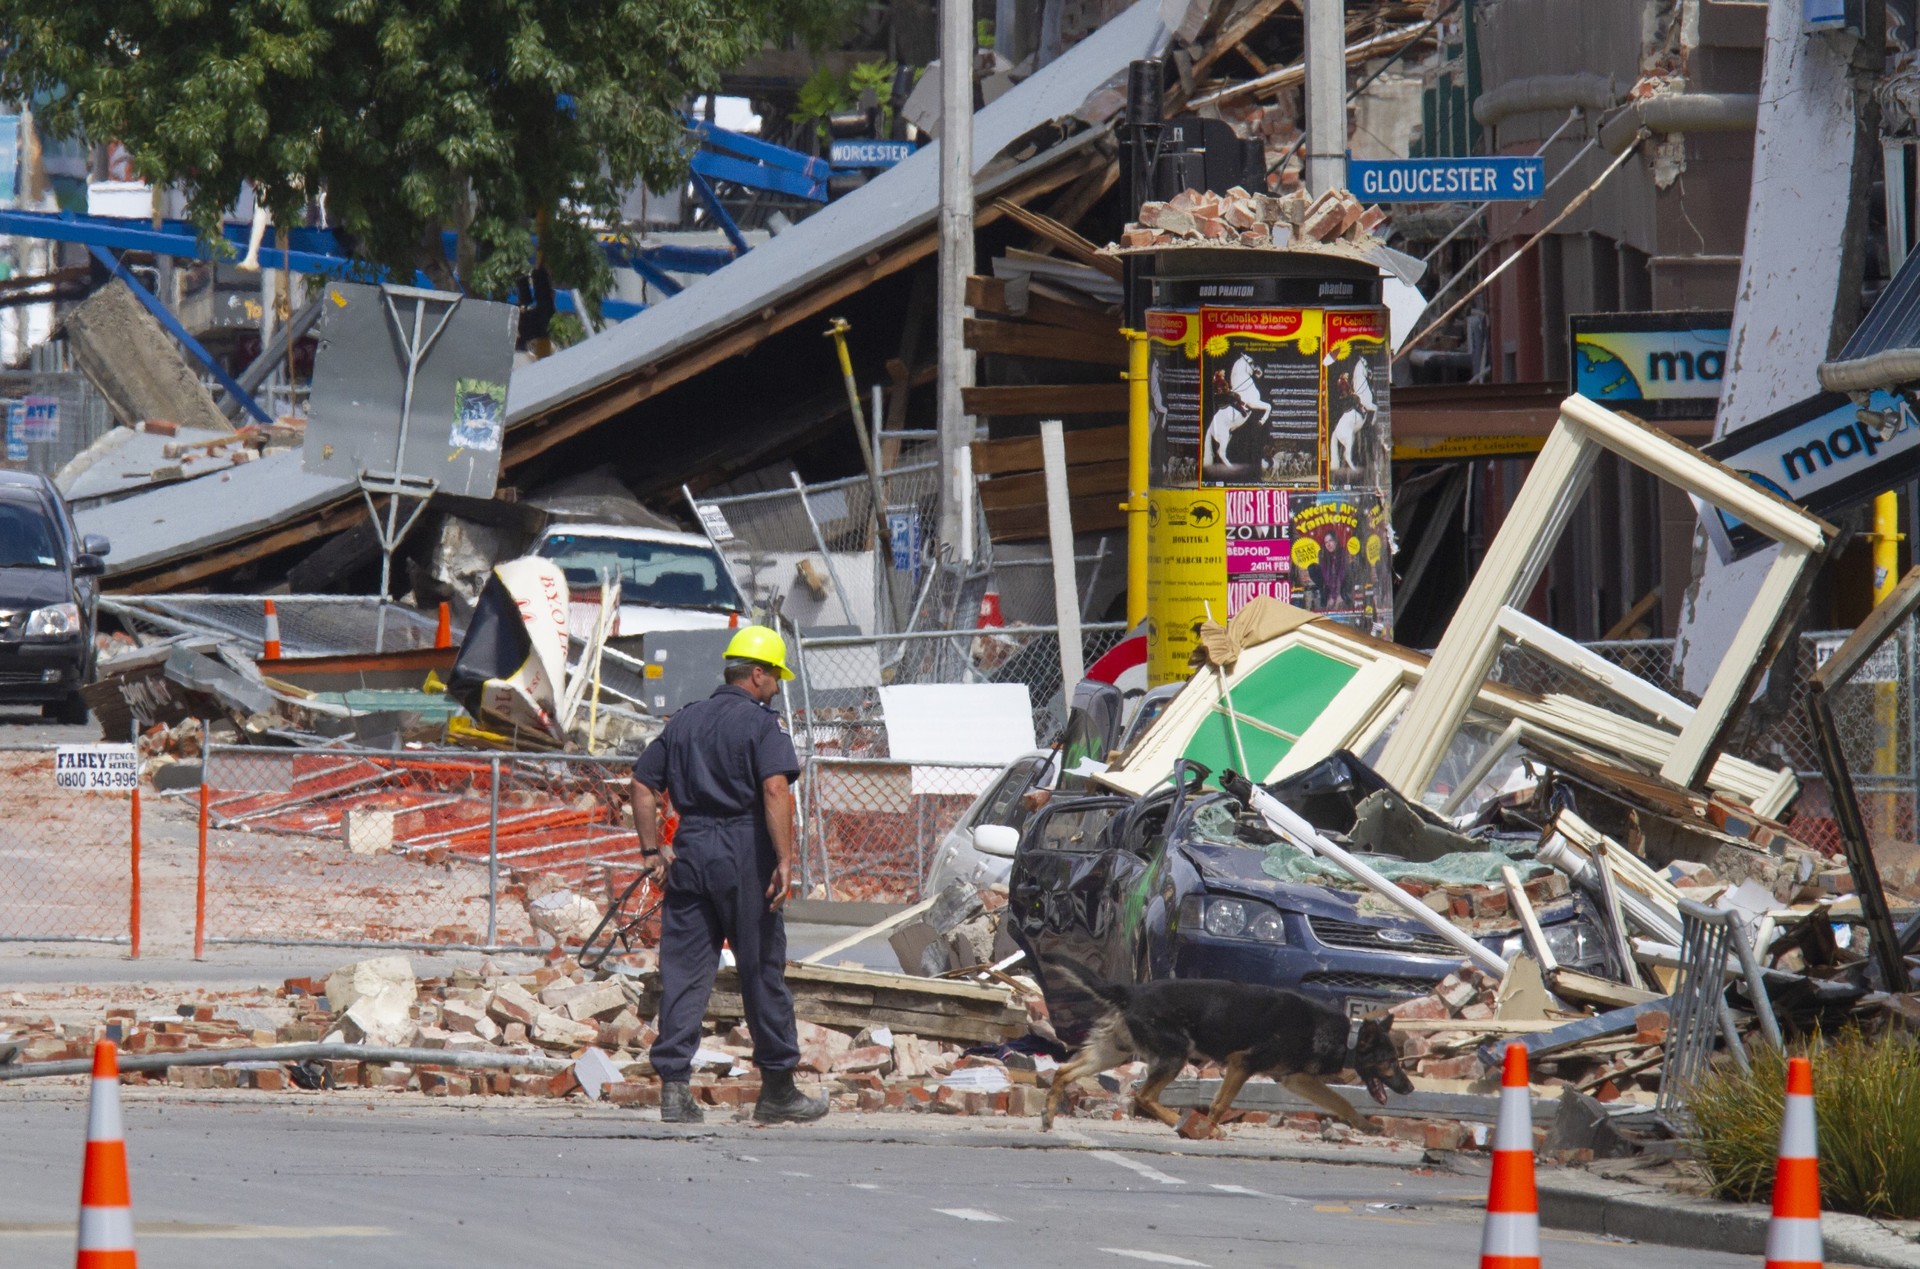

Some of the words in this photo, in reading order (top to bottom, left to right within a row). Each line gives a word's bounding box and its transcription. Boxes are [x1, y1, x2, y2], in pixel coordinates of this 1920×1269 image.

[832, 145, 909, 160] WORCESTER
[1364, 168, 1497, 193] GLOUCESTER
[1513, 167, 1536, 191] ST
[1218, 285, 1254, 297] PHANTOM
[1319, 282, 1353, 297] phantom
[1208, 312, 1218, 323] El
[1220, 312, 1259, 324] Caballo
[1261, 312, 1297, 325] Blanco
[1332, 315, 1342, 327] El
[1226, 490, 1255, 525] KIDS
[1256, 490, 1271, 525] OF
[1273, 490, 1288, 525] 88
[1296, 513, 1358, 533] Yankovic
[1226, 525, 1290, 540] ZOWIE
[1172, 536, 1209, 544] HOKITIKA
[1226, 546, 1270, 556] BEDFORD
[1177, 556, 1202, 564] MARCH
[1205, 556, 1222, 564] 2011
[1251, 562, 1272, 571] 24TH
[1274, 562, 1290, 571] FEB
[57, 752, 108, 769] FAHEY
[109, 752, 136, 760] FENCE
[57, 771, 86, 788] 0800
[90, 771, 137, 788] 343-996
